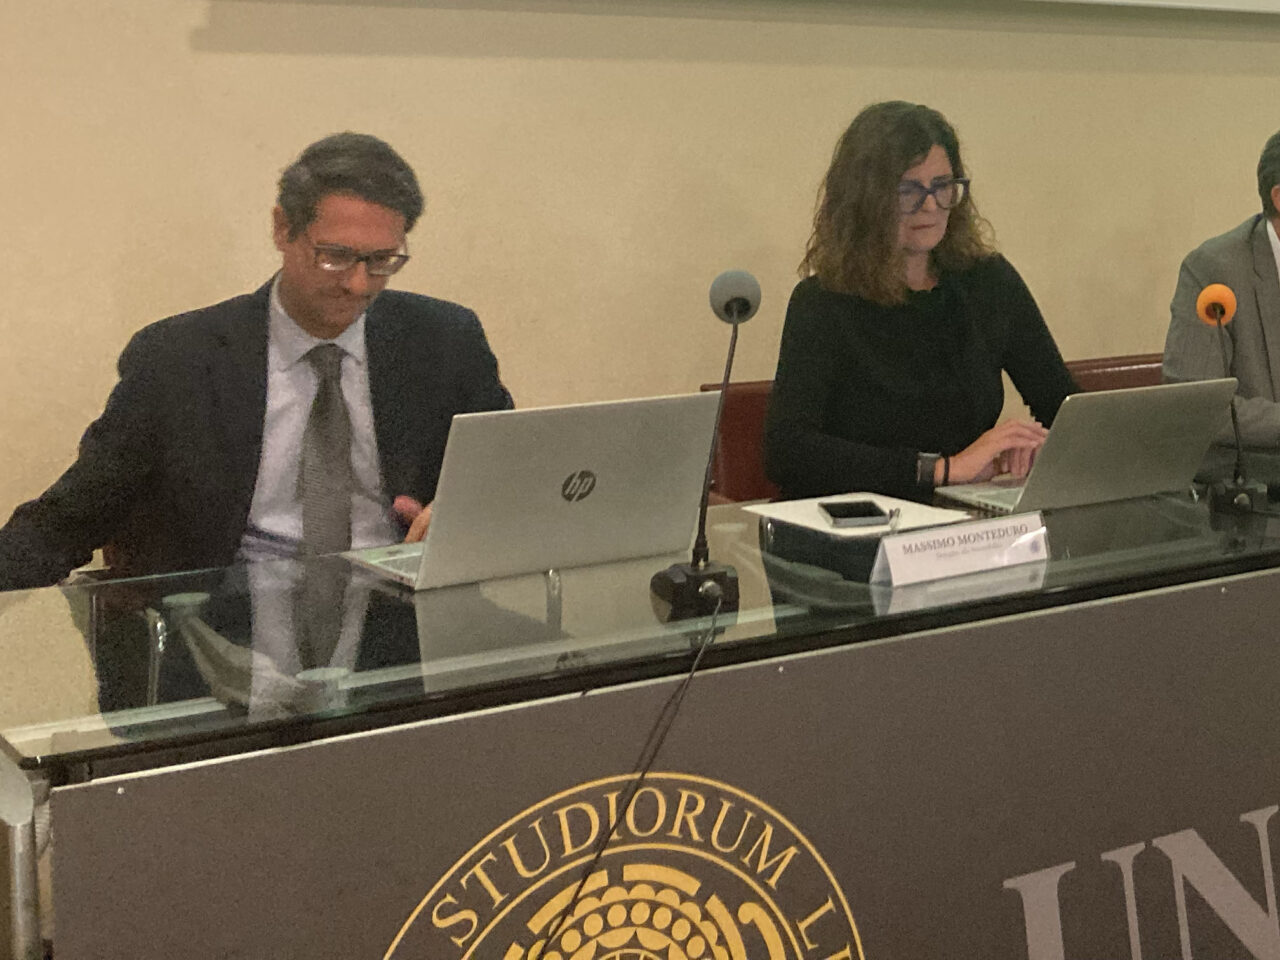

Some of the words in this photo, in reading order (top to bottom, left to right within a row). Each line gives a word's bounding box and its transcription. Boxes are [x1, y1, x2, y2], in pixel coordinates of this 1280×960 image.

[902, 536, 956, 555] MASSIMO
[958, 523, 1029, 546] MONTEDURO
[431, 787, 800, 948] STUDIORUM
